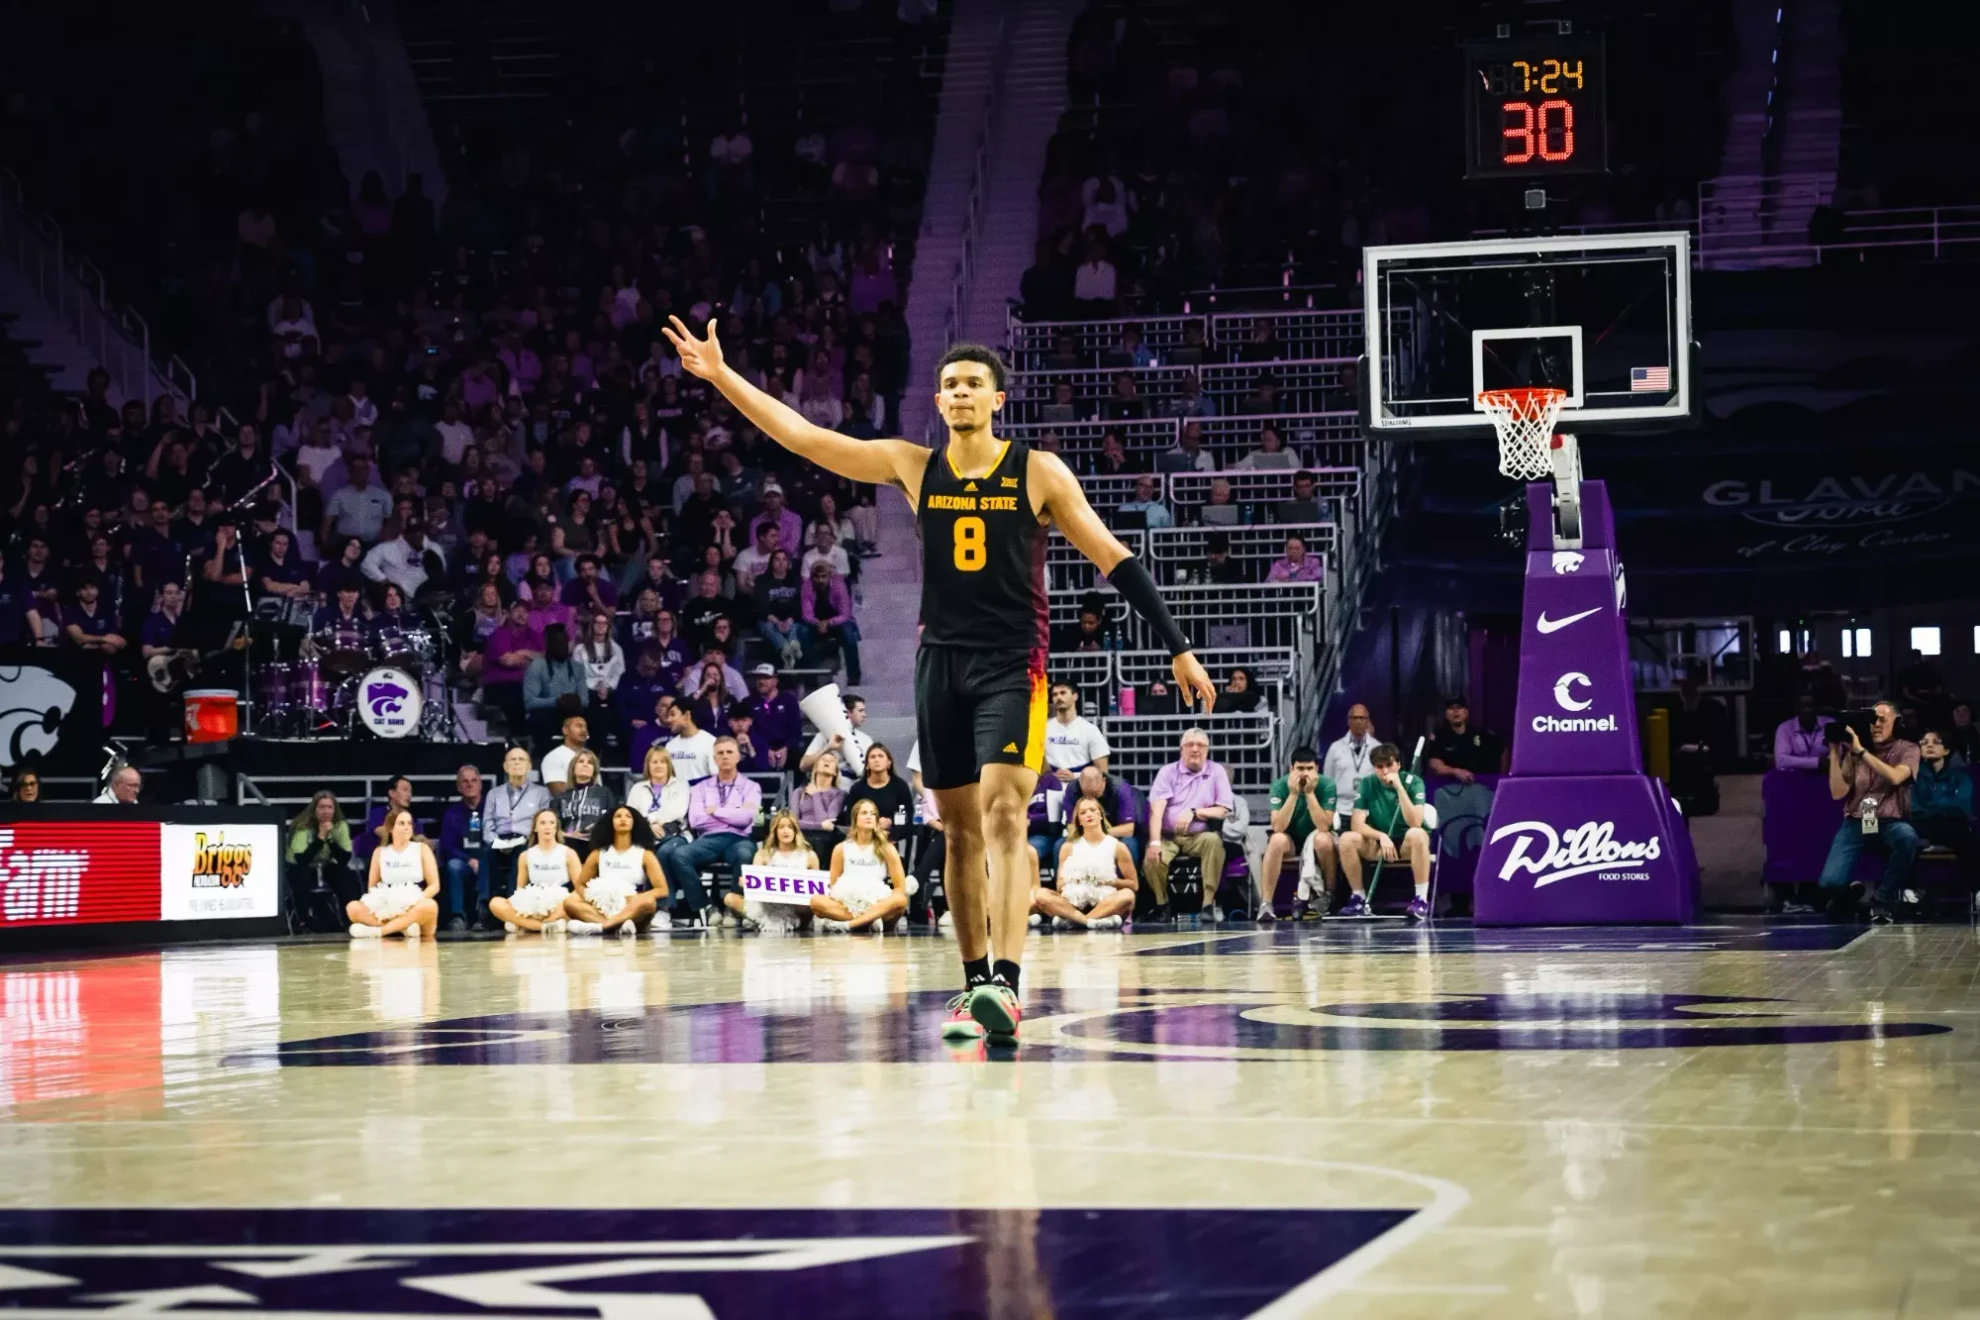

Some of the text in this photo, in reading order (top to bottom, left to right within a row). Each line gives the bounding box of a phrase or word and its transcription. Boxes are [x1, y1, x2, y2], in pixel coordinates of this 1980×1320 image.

[1513, 59, 1583, 93] 7:24
[1503, 100, 1574, 163] 30
[1381, 419, 1412, 427] SPALDING
[928, 495, 1018, 511] ARIZONA STATE
[954, 516, 987, 571] 8
[193, 831, 251, 888] Briggs
[1490, 821, 1660, 882] Dillons
[745, 875, 832, 895] DEFEN
[1598, 872, 1650, 881] FOOD STORES
